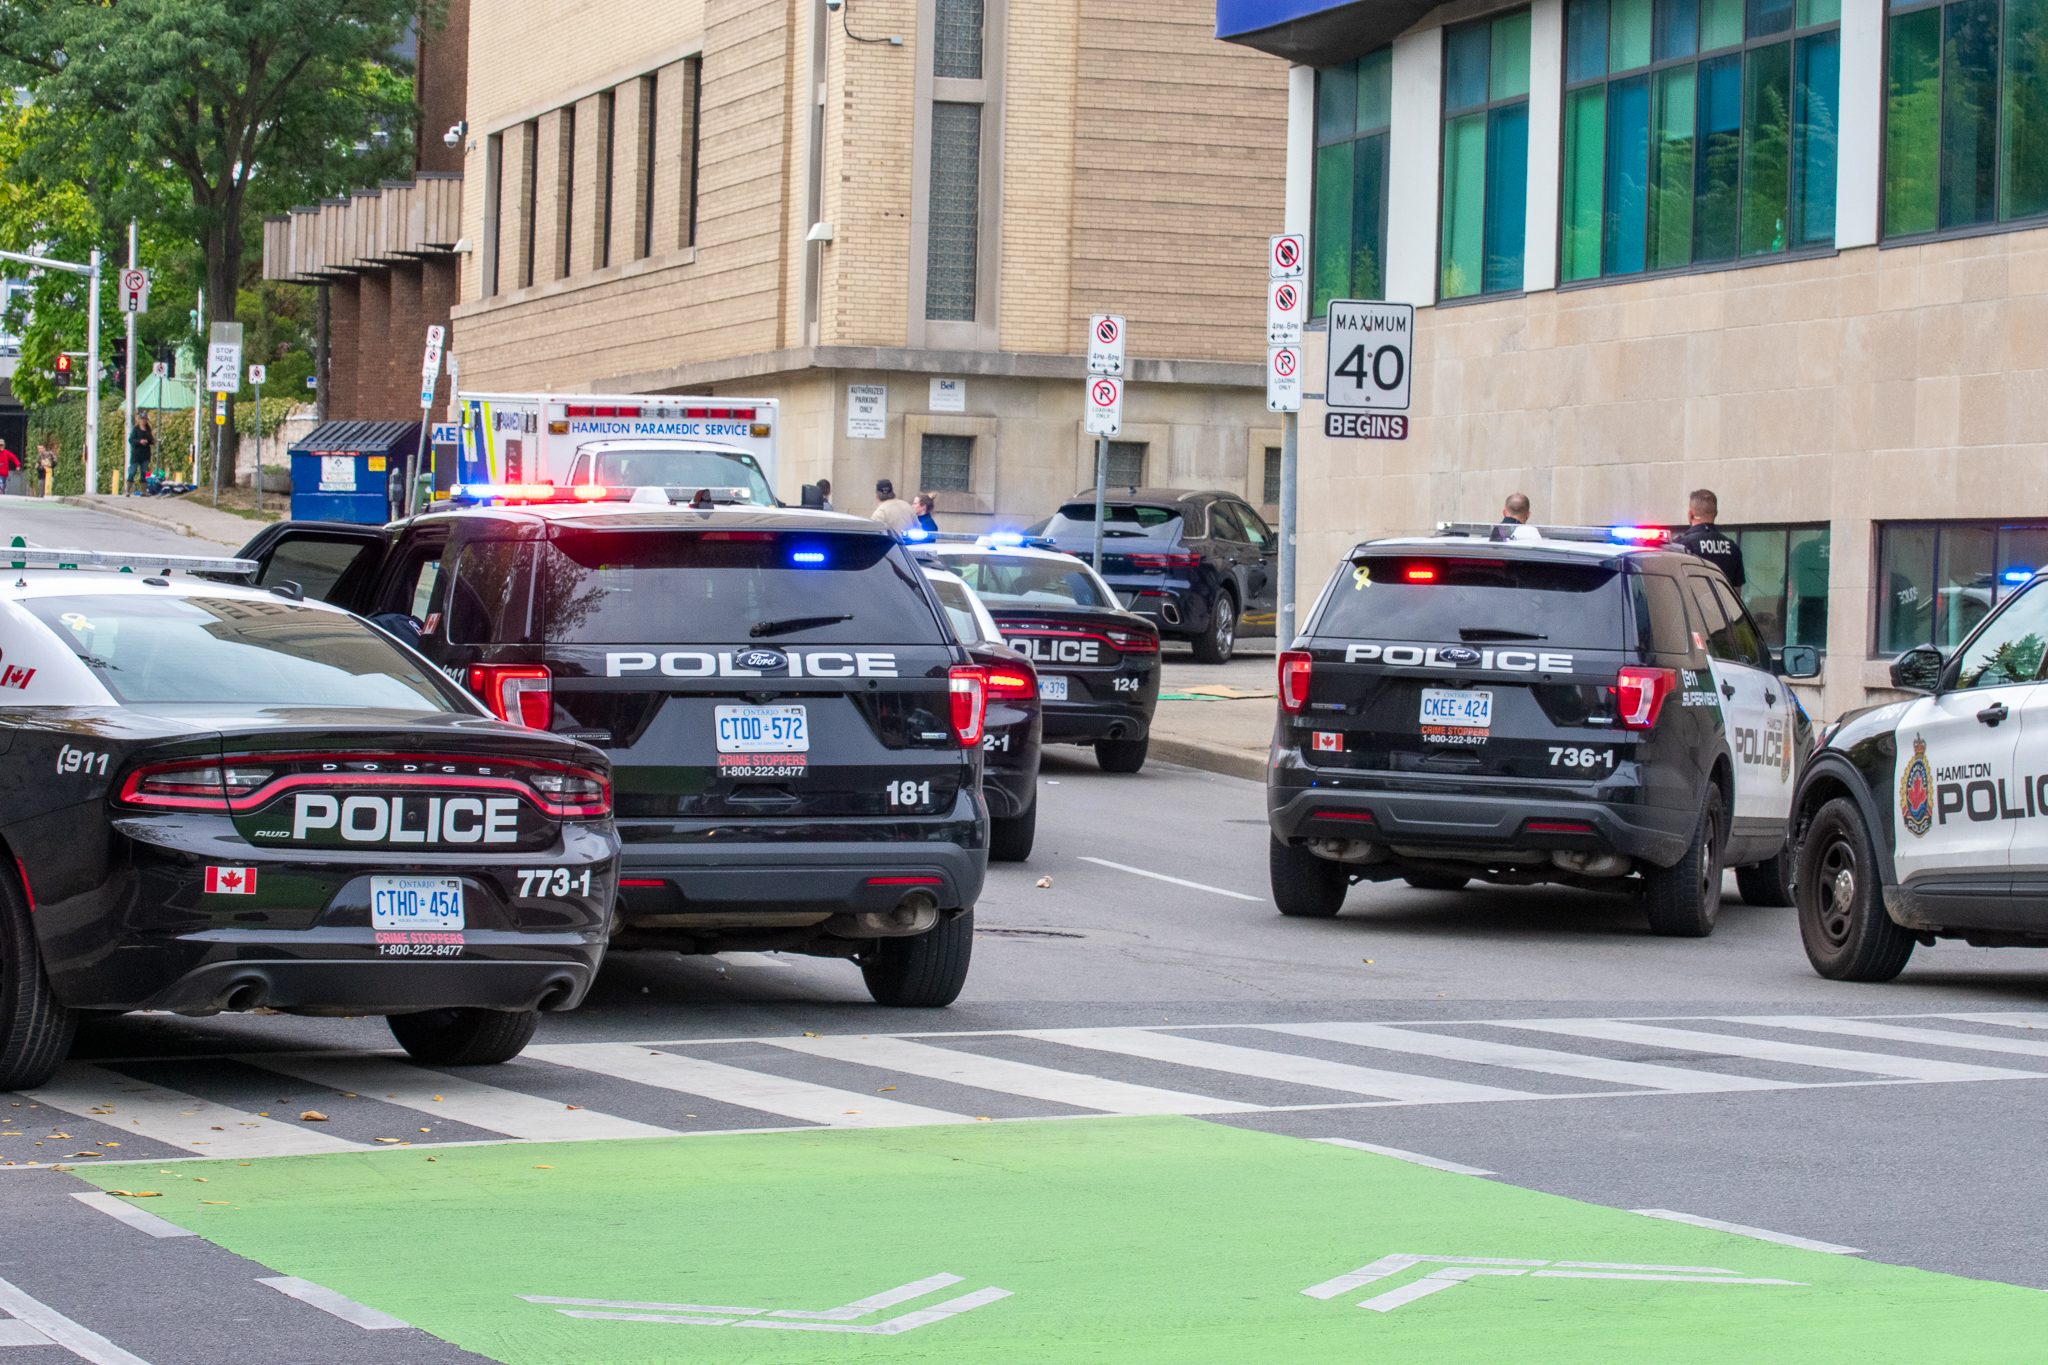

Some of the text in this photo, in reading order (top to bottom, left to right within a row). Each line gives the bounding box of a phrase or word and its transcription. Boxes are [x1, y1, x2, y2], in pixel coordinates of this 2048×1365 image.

[1336, 313, 1407, 332] MAXIMUM
[1334, 343, 1405, 391] 40
[210, 380, 236, 388] SIGNAL
[850, 386, 884, 395] AUTHORIZED
[940, 380, 955, 390] Bell
[854, 396, 878, 404] PARKING
[572, 422, 748, 436] HAMILTON PARAMEDIC SERVICE
[1329, 415, 1404, 439] BEGINS
[1700, 540, 1731, 555] POLICE
[1003, 638, 1099, 663] OLICE
[606, 652, 899, 678] POLICE
[747, 654, 777, 667] Ford
[1345, 644, 1573, 674] POLICE
[1050, 682, 1066, 694] 379
[1112, 678, 1139, 692] 124
[743, 708, 779, 717] ONTARIO
[1424, 698, 1488, 718] CKEE 424
[720, 717, 804, 740] CTDD 572
[1421, 726, 1490, 737] CRIME STOPPERS
[1422, 734, 1488, 745] 1-800-222-8477
[1735, 727, 1783, 768] POLICE
[718, 754, 806, 766] CRIME STOPPERS
[1548, 747, 1614, 769] 736-1
[322, 763, 491, 775] DODGE
[721, 766, 805, 777] 1-800-222-8477
[1936, 762, 1991, 782] HAMILTON
[886, 780, 930, 806] 181
[293, 794, 519, 843] POLICE
[1907, 819, 1929, 834] POLICE
[254, 830, 291, 838] AWD
[399, 880, 436, 889] ONTARIO
[516, 867, 591, 898] 773-1
[376, 890, 459, 917] CTHD 454
[375, 932, 465, 945] CRIME STOPPERS
[379, 944, 464, 956] 1-800-222-8477
